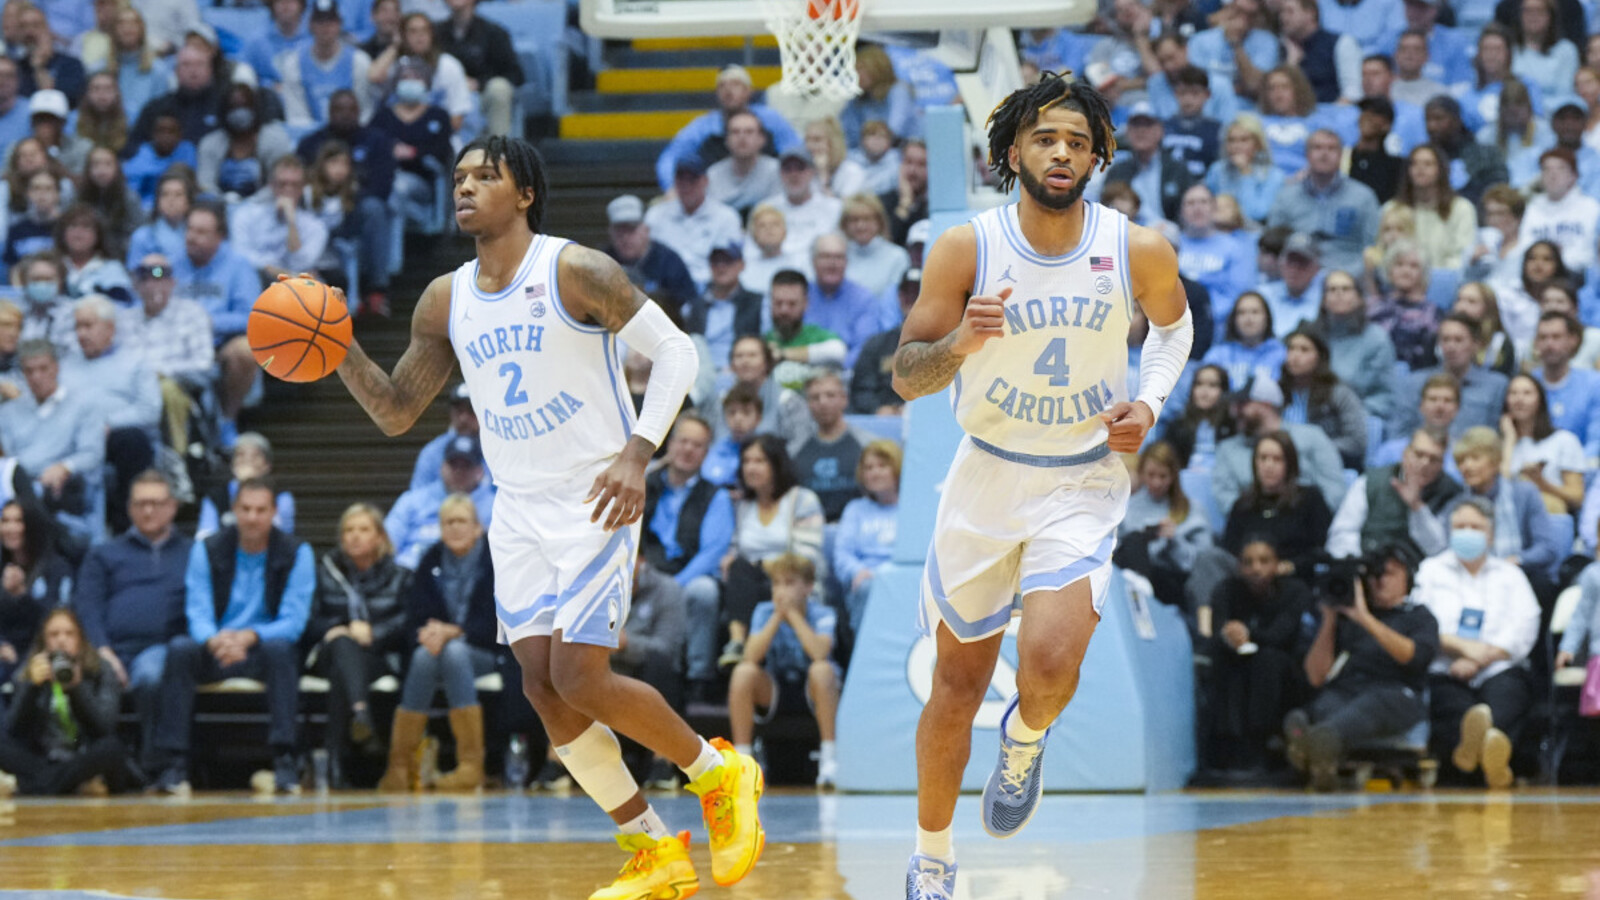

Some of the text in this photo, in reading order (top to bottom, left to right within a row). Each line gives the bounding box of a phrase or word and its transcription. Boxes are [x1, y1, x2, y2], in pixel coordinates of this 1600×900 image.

[1004, 296, 1112, 335] NORTH
[465, 324, 544, 368] NORTH
[1033, 337, 1070, 386] 4
[498, 361, 528, 407] 2
[484, 390, 584, 440] CAROLINA
